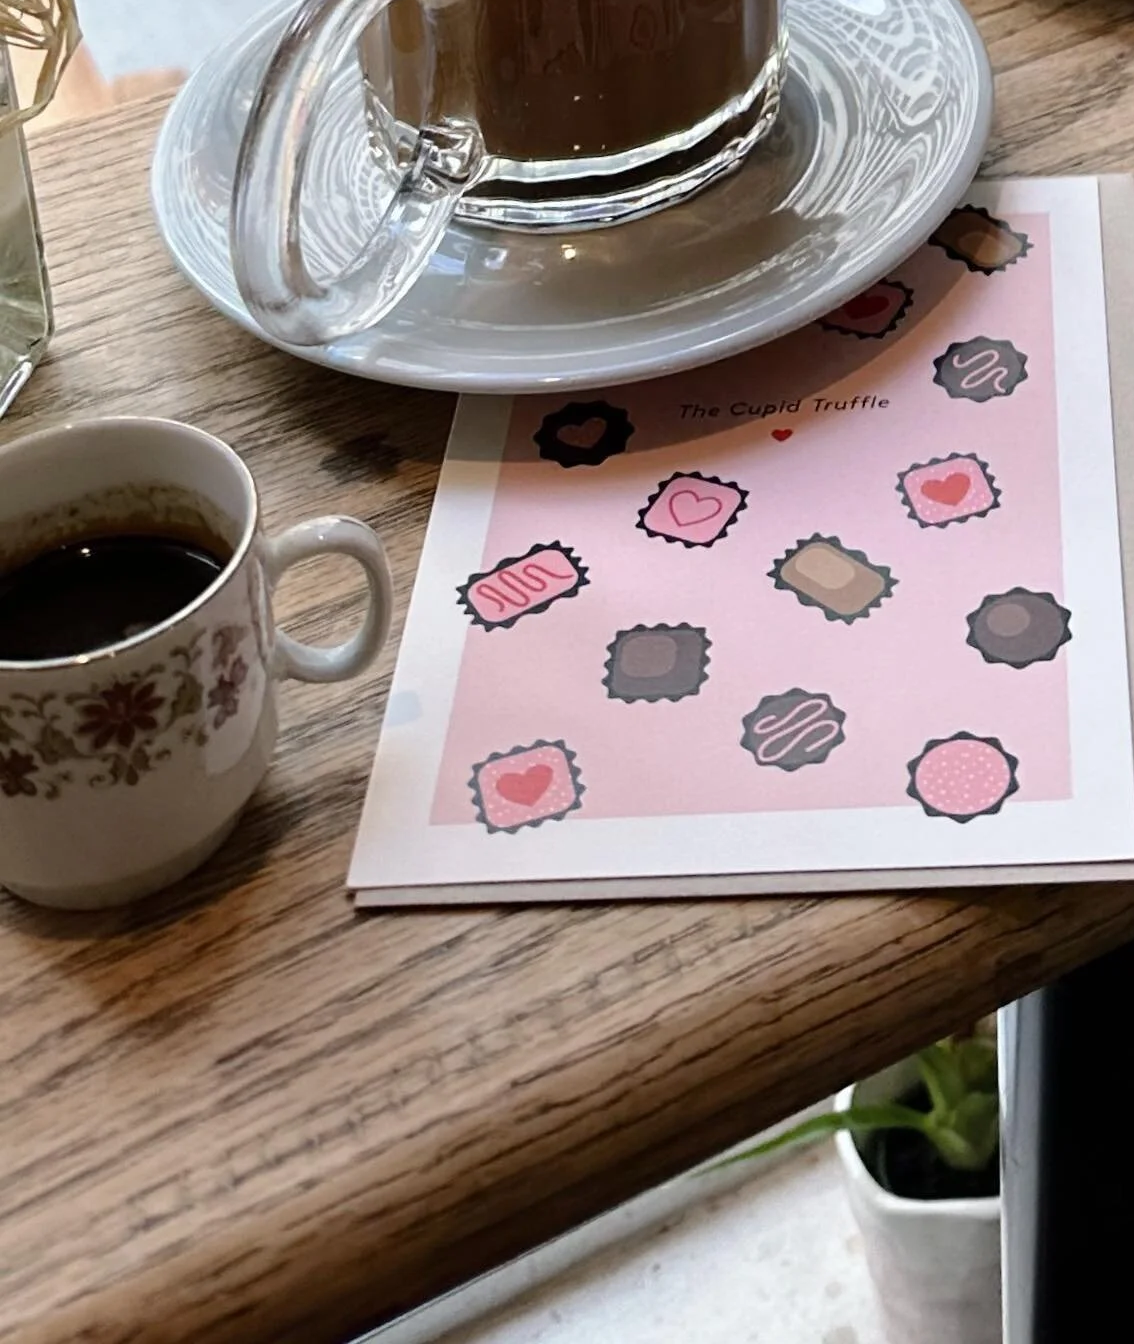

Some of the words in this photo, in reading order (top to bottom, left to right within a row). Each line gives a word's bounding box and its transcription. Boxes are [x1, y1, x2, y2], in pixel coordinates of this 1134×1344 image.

[680, 403, 719, 419] The
[730, 399, 801, 419] Cupid
[813, 395, 890, 413] Truffle
